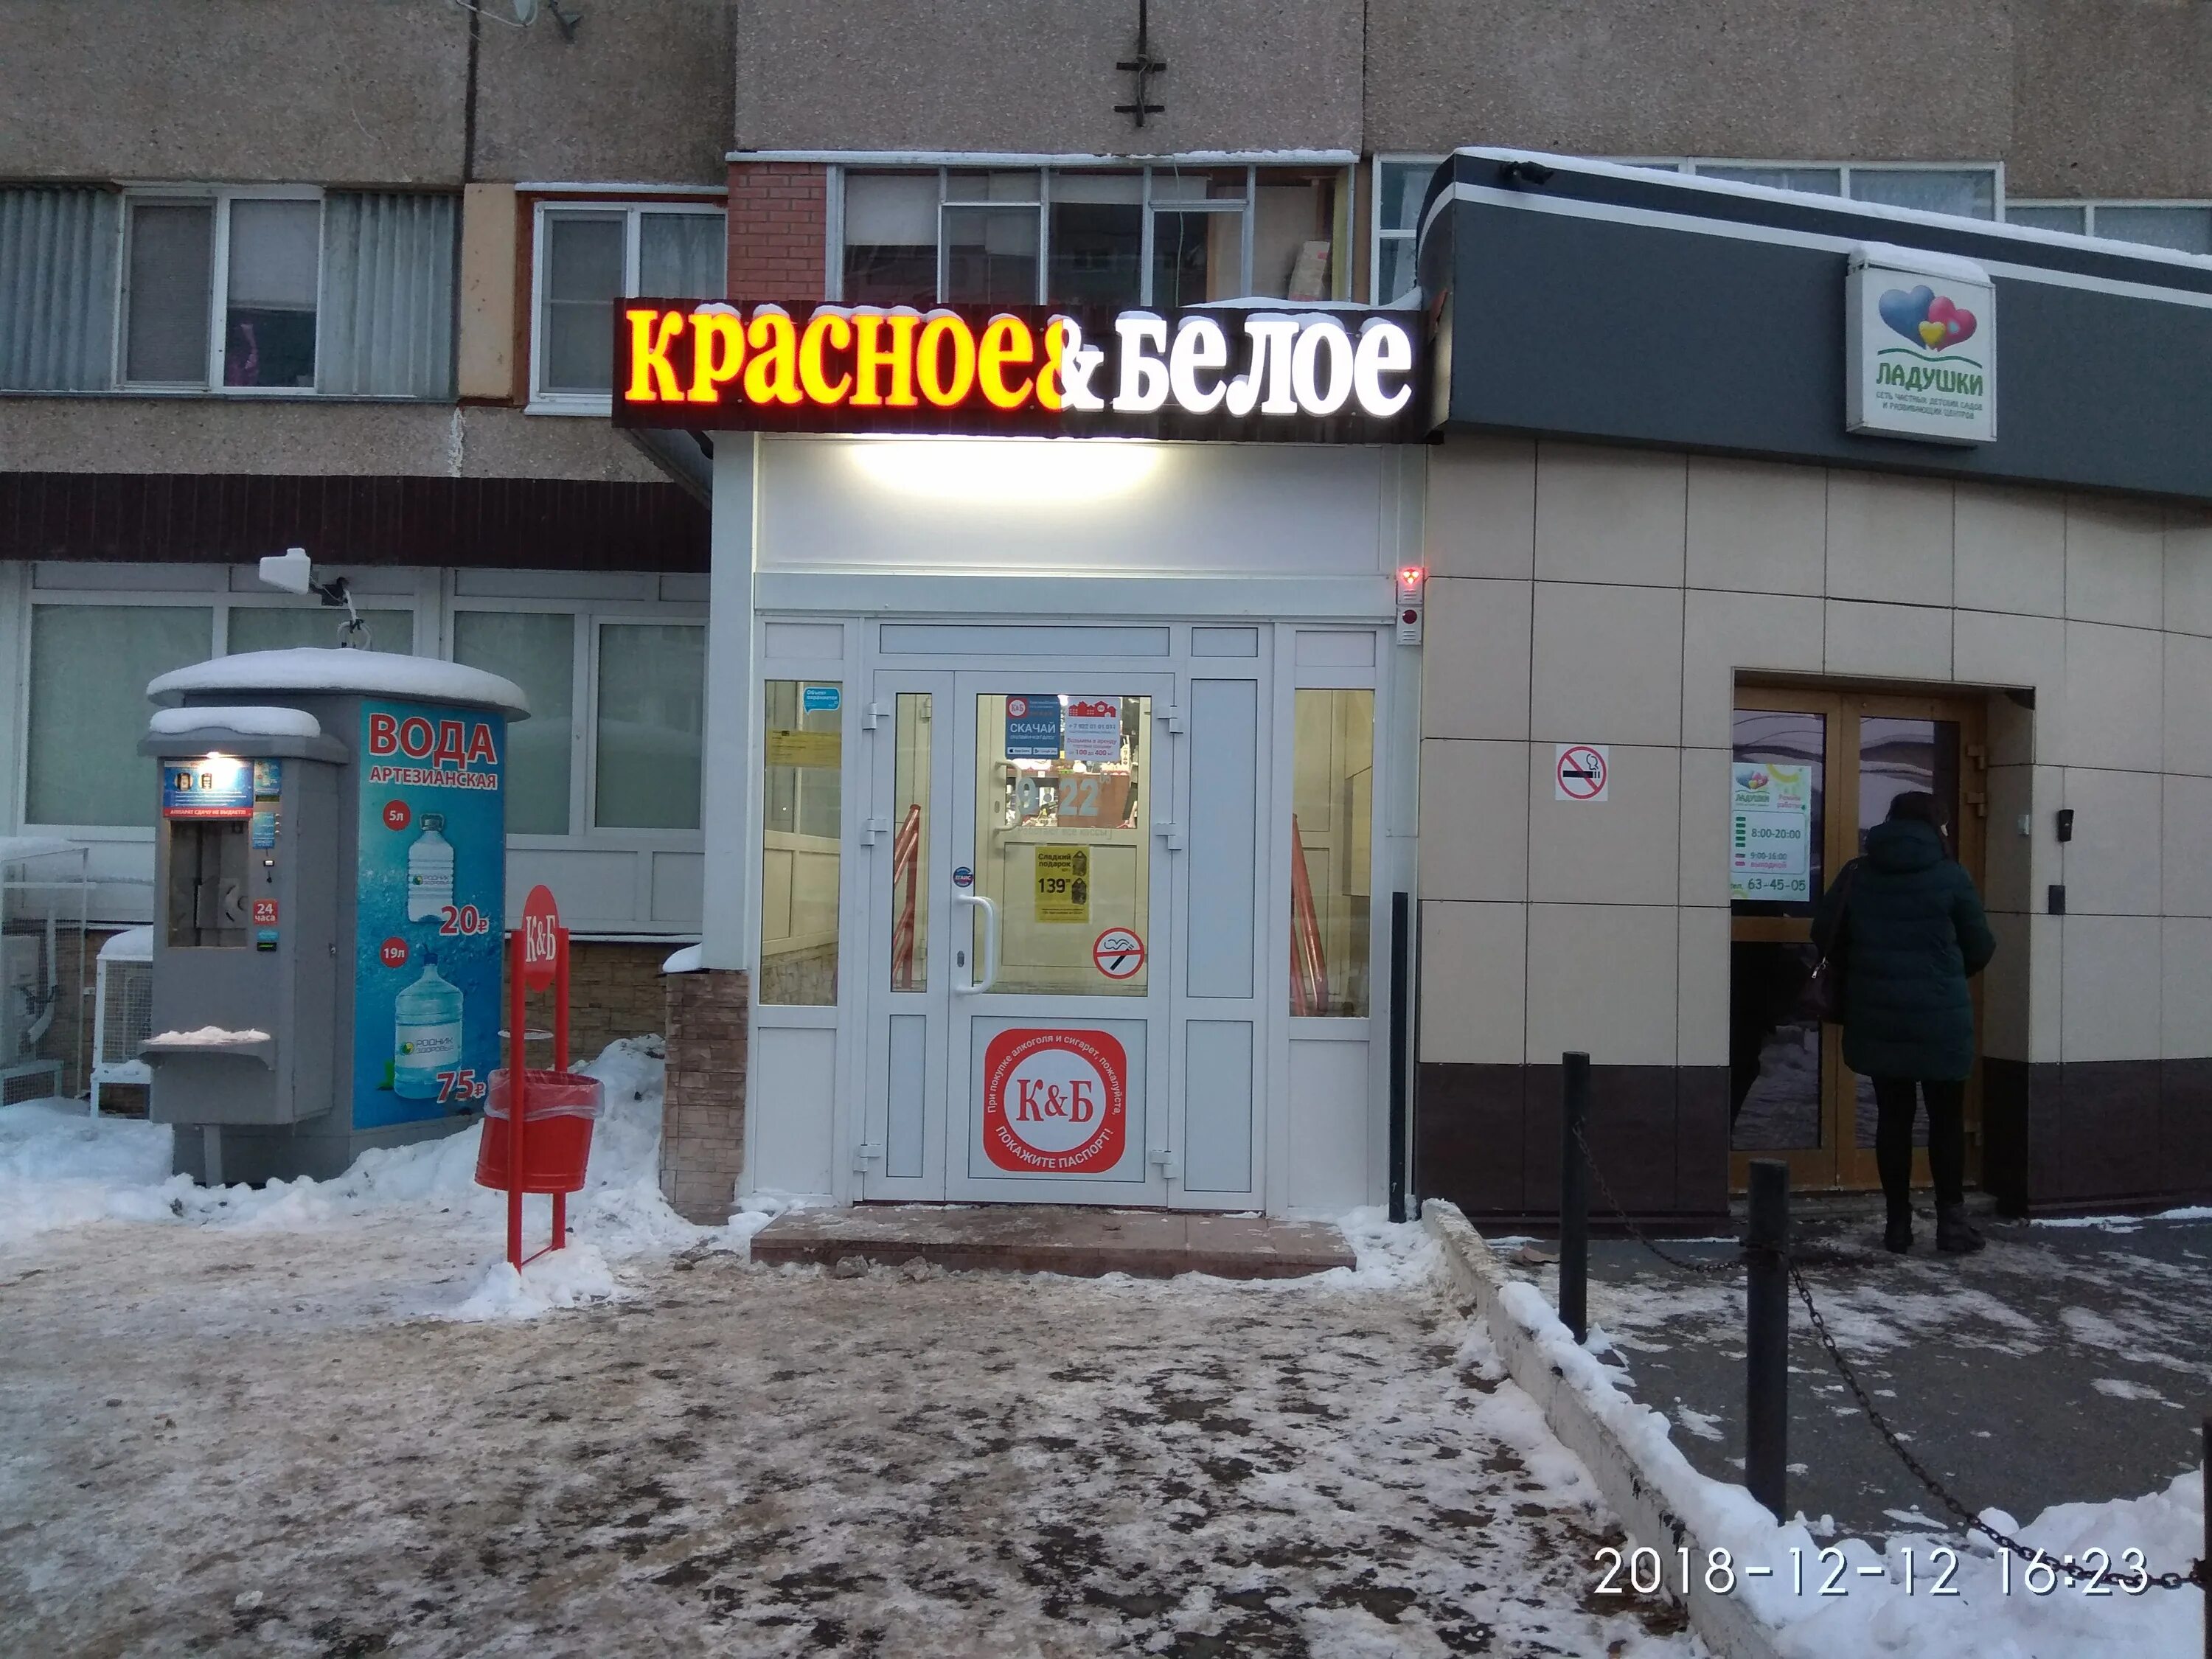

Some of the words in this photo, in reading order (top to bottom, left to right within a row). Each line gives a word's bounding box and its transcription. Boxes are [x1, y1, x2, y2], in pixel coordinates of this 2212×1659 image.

[1876, 362, 1983, 396] ЛАДУШКИ
[1009, 722, 1056, 734] СКАЧАЙ
[369, 713, 498, 771] ВОДА
[369, 765, 498, 790] АРТЕЗИАНСКАЯ
[389, 810, 404, 821] 5л
[1750, 828, 1801, 839] 8:00-20:00
[1038, 853, 1071, 861] Сладкий
[1750, 852, 1788, 860] 9:00-16:00
[1747, 877, 1806, 892] 63-45-05
[257, 903, 274, 914] 24
[525, 914, 557, 962] К&Б
[383, 947, 405, 959] 19л
[416, 1037, 454, 1046] РОДНИК
[1012, 1034, 1054, 1057] алкоголя
[1064, 1036, 1100, 1060] сигарет,
[990, 1055, 1013, 1093] покупке
[987, 1093, 997, 1113] При
[1015, 1079, 1094, 1123] К&Б
[995, 1125, 1057, 1169] ПОКАЖИТЕ
[1058, 1127, 1115, 1169] ПАСПОРТ!
